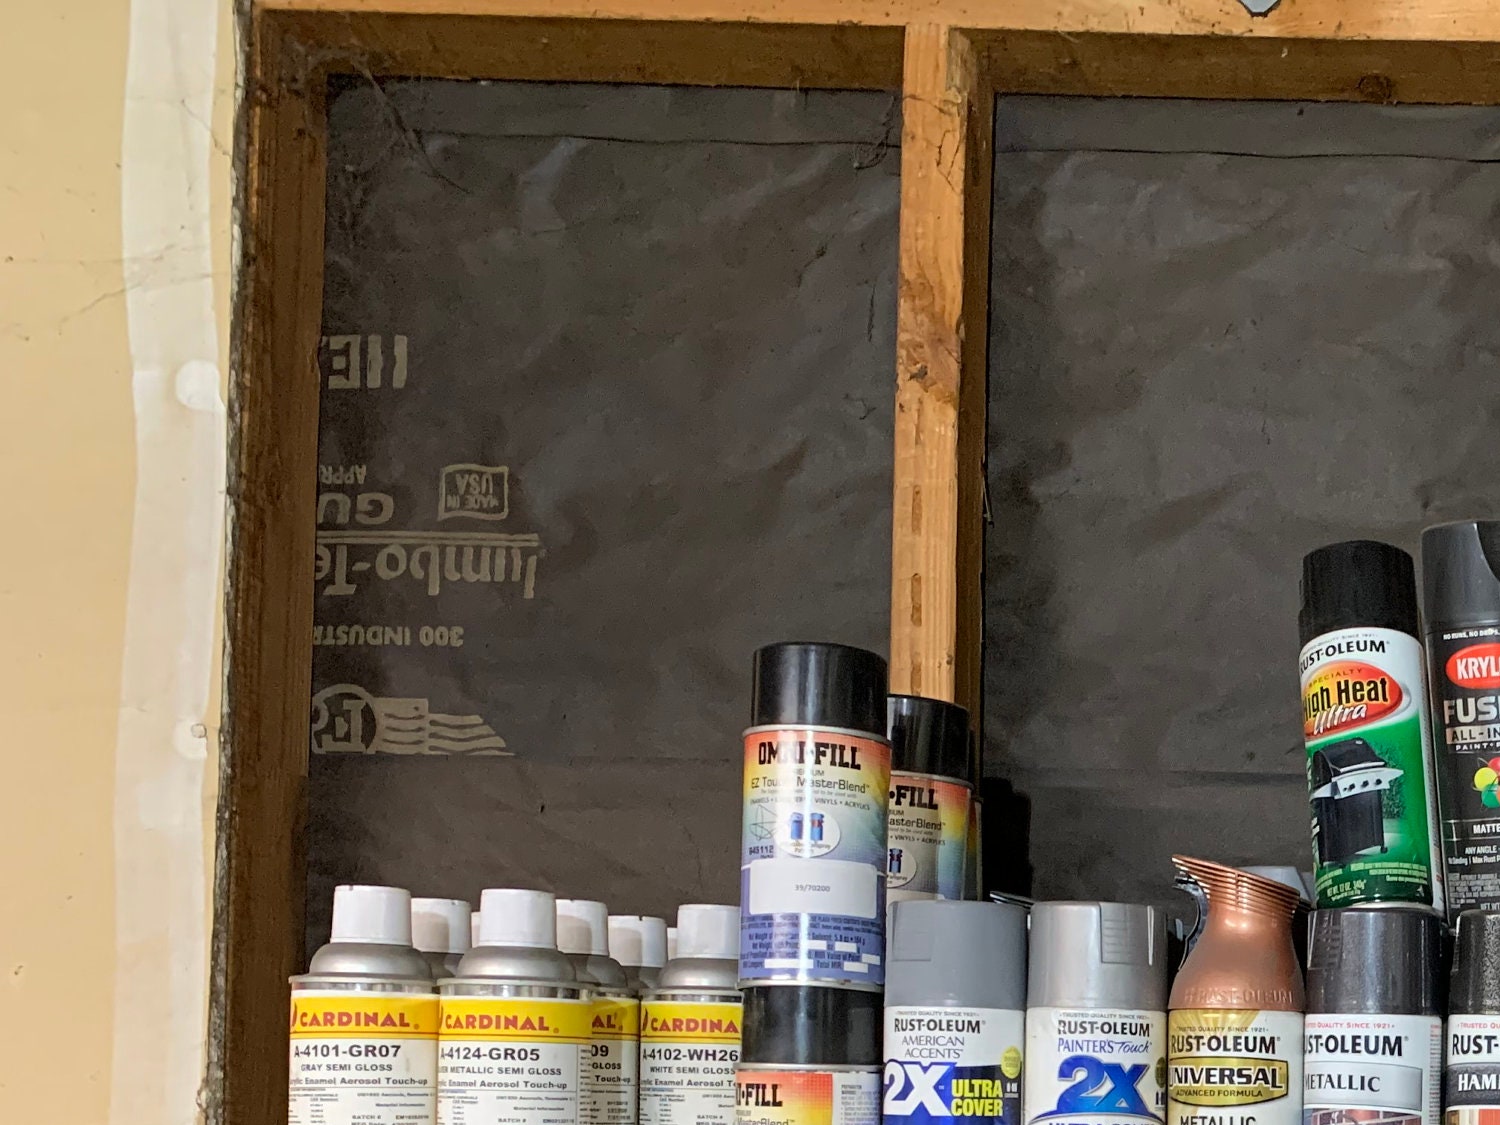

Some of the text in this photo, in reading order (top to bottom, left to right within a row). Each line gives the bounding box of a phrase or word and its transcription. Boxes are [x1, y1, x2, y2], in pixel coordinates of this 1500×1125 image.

[419, 625, 464, 647] 300
[1337, 678, 1388, 705] Heat
[300, 1012, 410, 1027] CARDINAL
[446, 1015, 549, 1030] CARDINAL
[651, 1019, 739, 1033] CARDINA
[894, 1018, 981, 1033] RUST-OLEUM
[1058, 1020, 1150, 1036] RUST-OLEUM
[902, 1035, 965, 1047] AMERICAN
[294, 1045, 401, 1057] A-4101-GR07
[905, 1048, 960, 1059] ACCENTS
[523, 1081, 567, 1090] Touch-up
[952, 1079, 1002, 1098] ULTRA
[1057, 1055, 1149, 1110] 2X
[1217, 1089, 1263, 1098] FORMULA
[952, 1100, 1002, 1116] COVER
